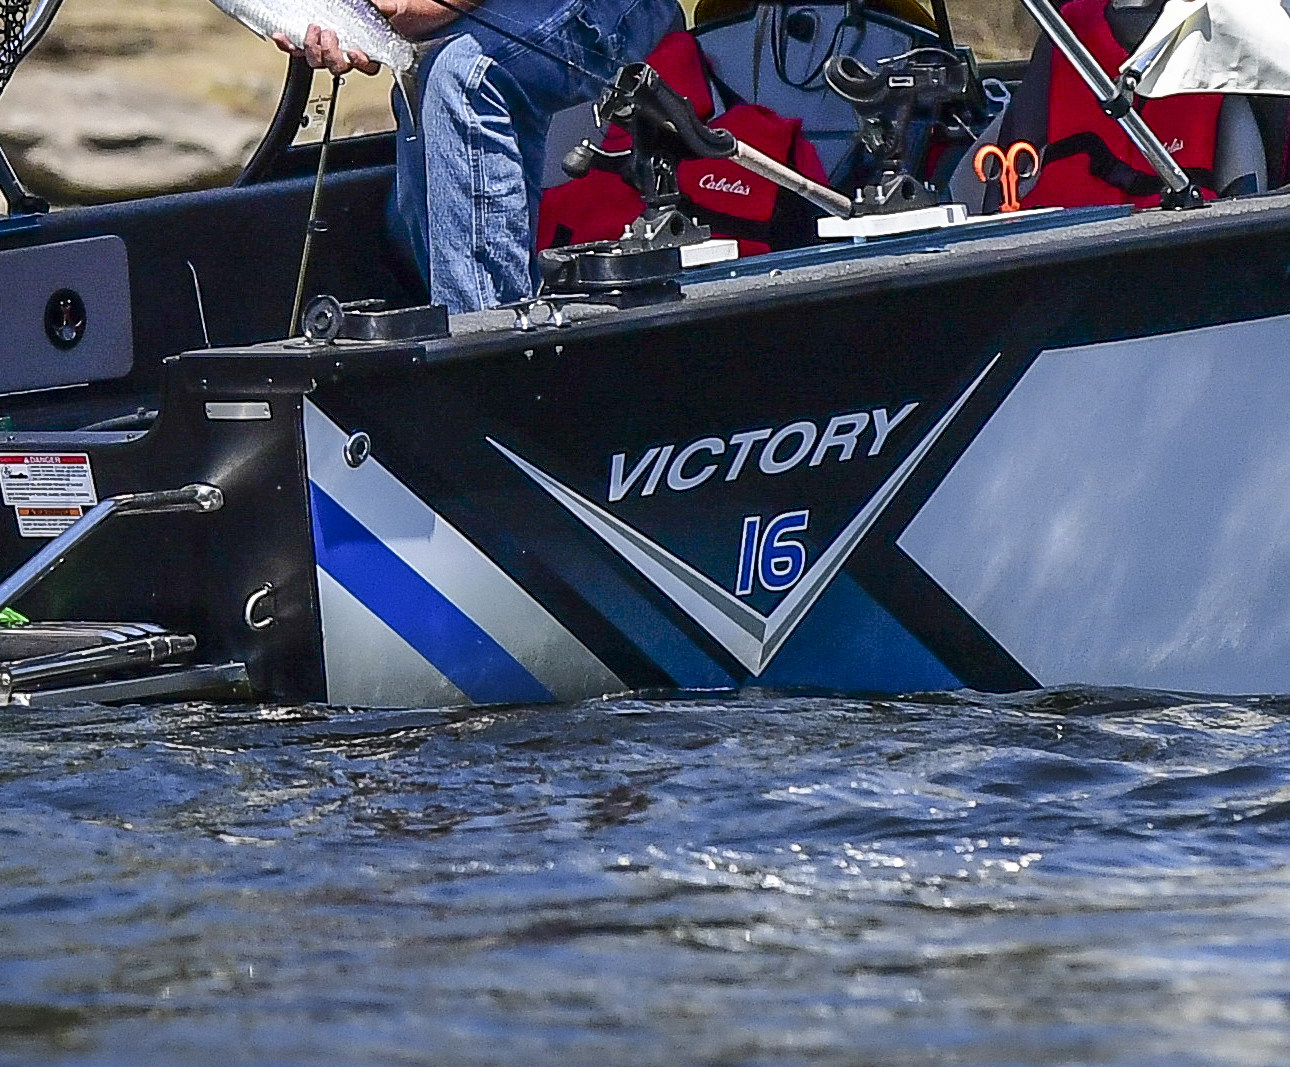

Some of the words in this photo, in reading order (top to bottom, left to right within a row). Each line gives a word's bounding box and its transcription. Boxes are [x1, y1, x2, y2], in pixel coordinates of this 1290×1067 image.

[29, 456, 61, 464] DANGER
[605, 401, 920, 503] VICTORY
[734, 509, 811, 597] 16
